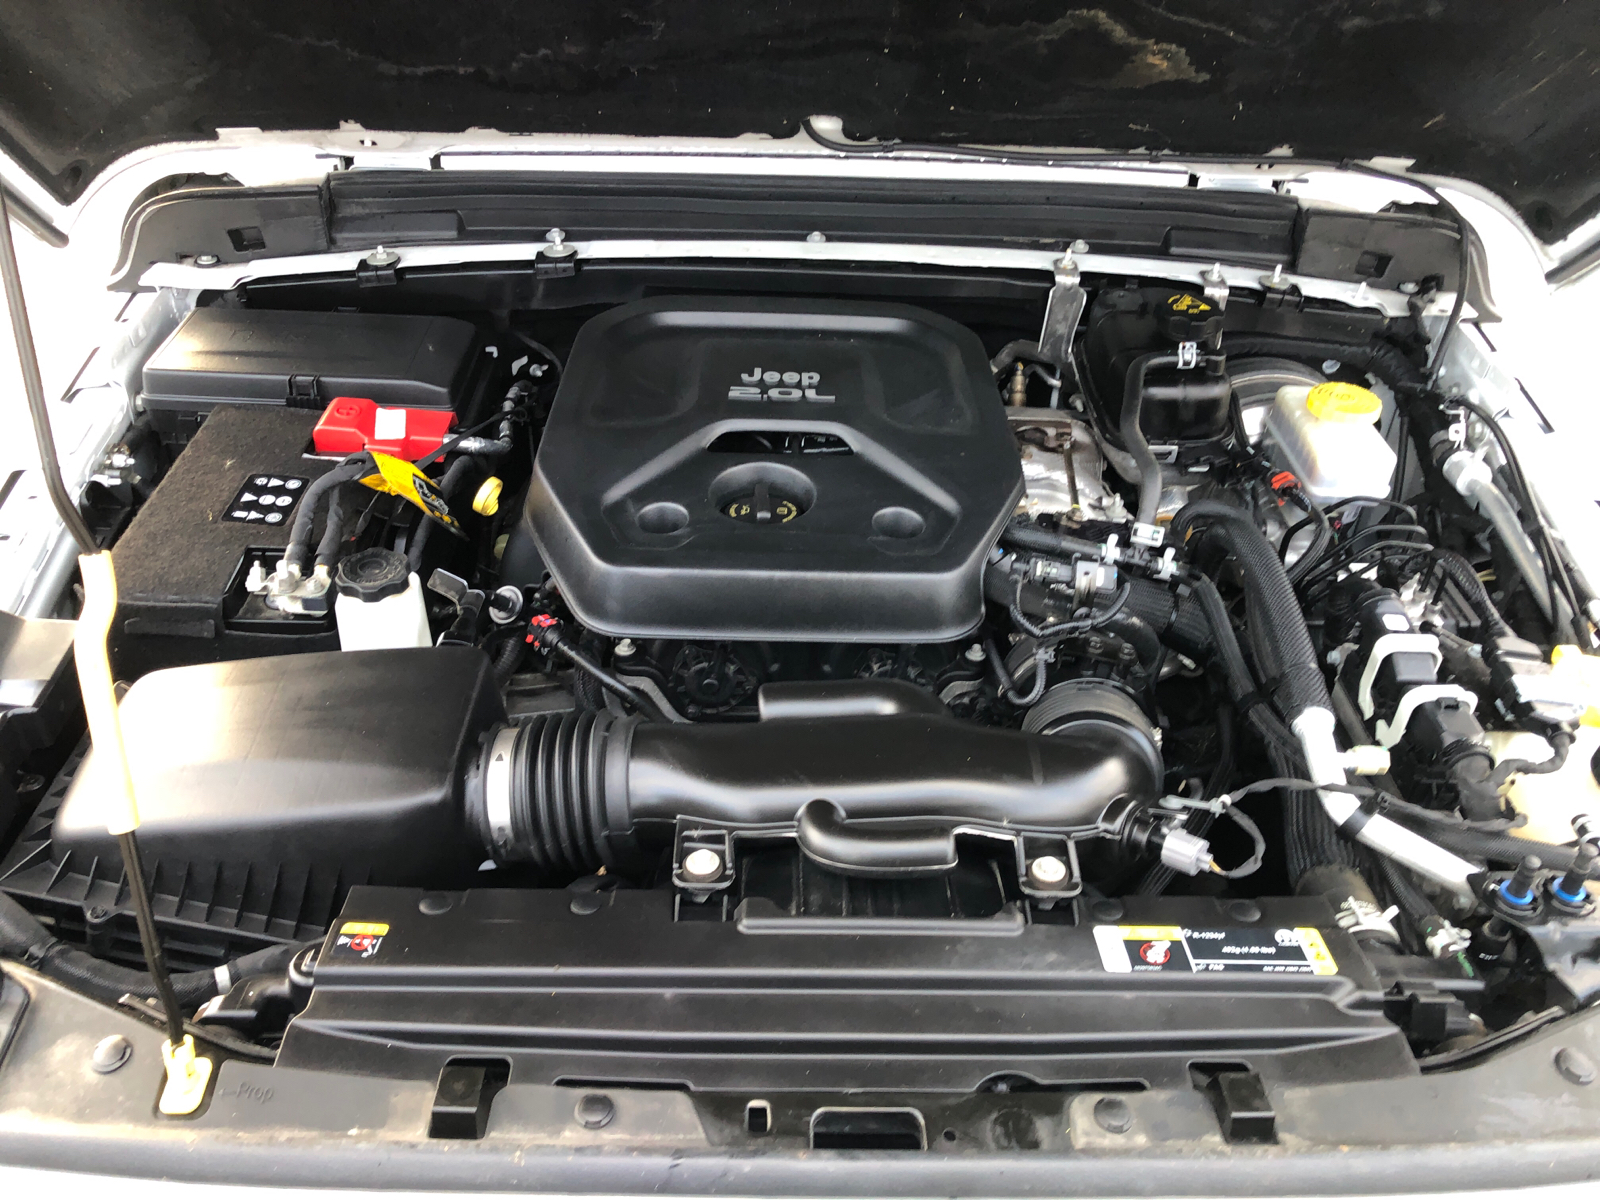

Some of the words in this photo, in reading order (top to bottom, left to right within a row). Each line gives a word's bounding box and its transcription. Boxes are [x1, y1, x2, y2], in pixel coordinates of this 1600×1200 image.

[740, 367, 821, 388] Jeep
[728, 386, 836, 403] 2.0L
[236, 1082, 274, 1105] Prop
